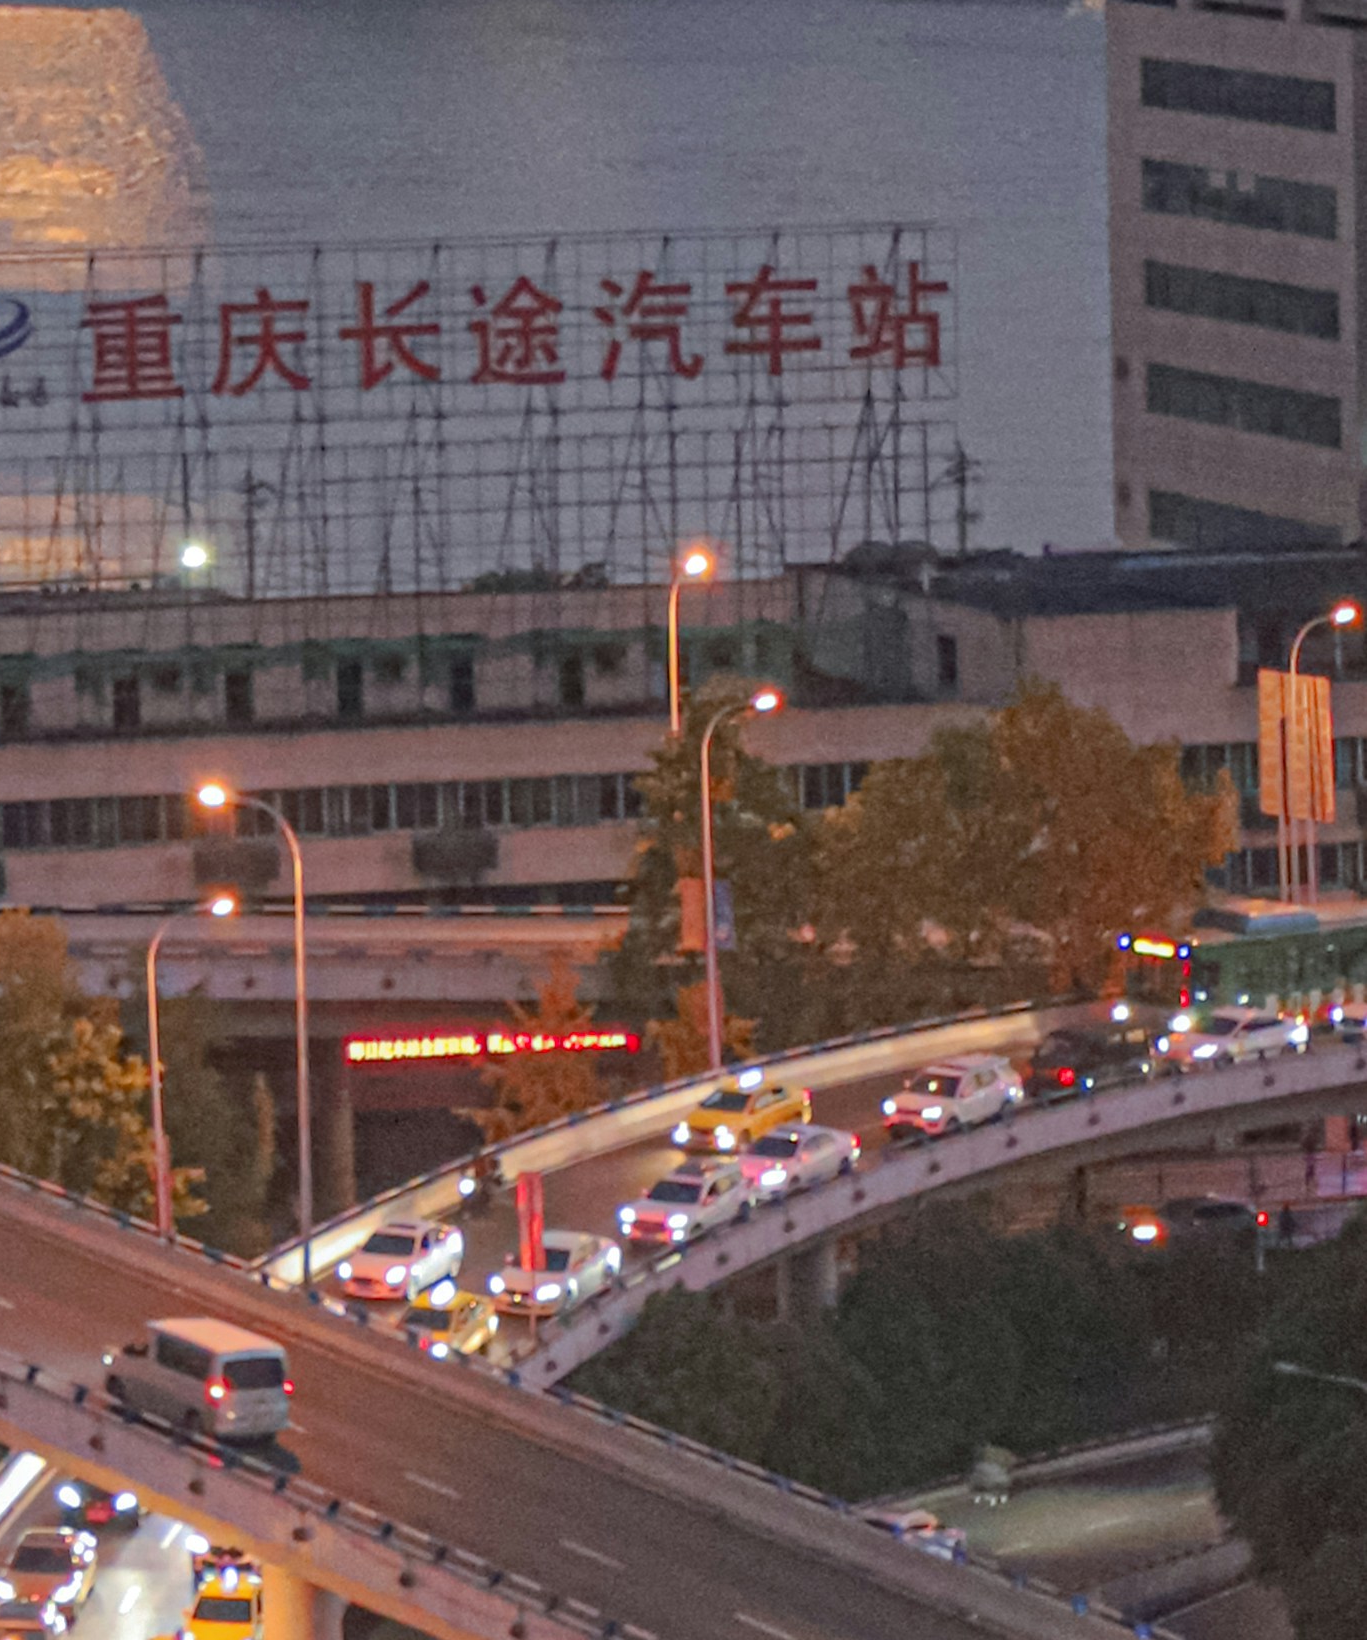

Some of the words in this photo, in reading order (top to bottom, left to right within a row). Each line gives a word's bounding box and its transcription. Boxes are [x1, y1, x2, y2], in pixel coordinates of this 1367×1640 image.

[81, 259, 950, 402] 重庆长途汽车站
